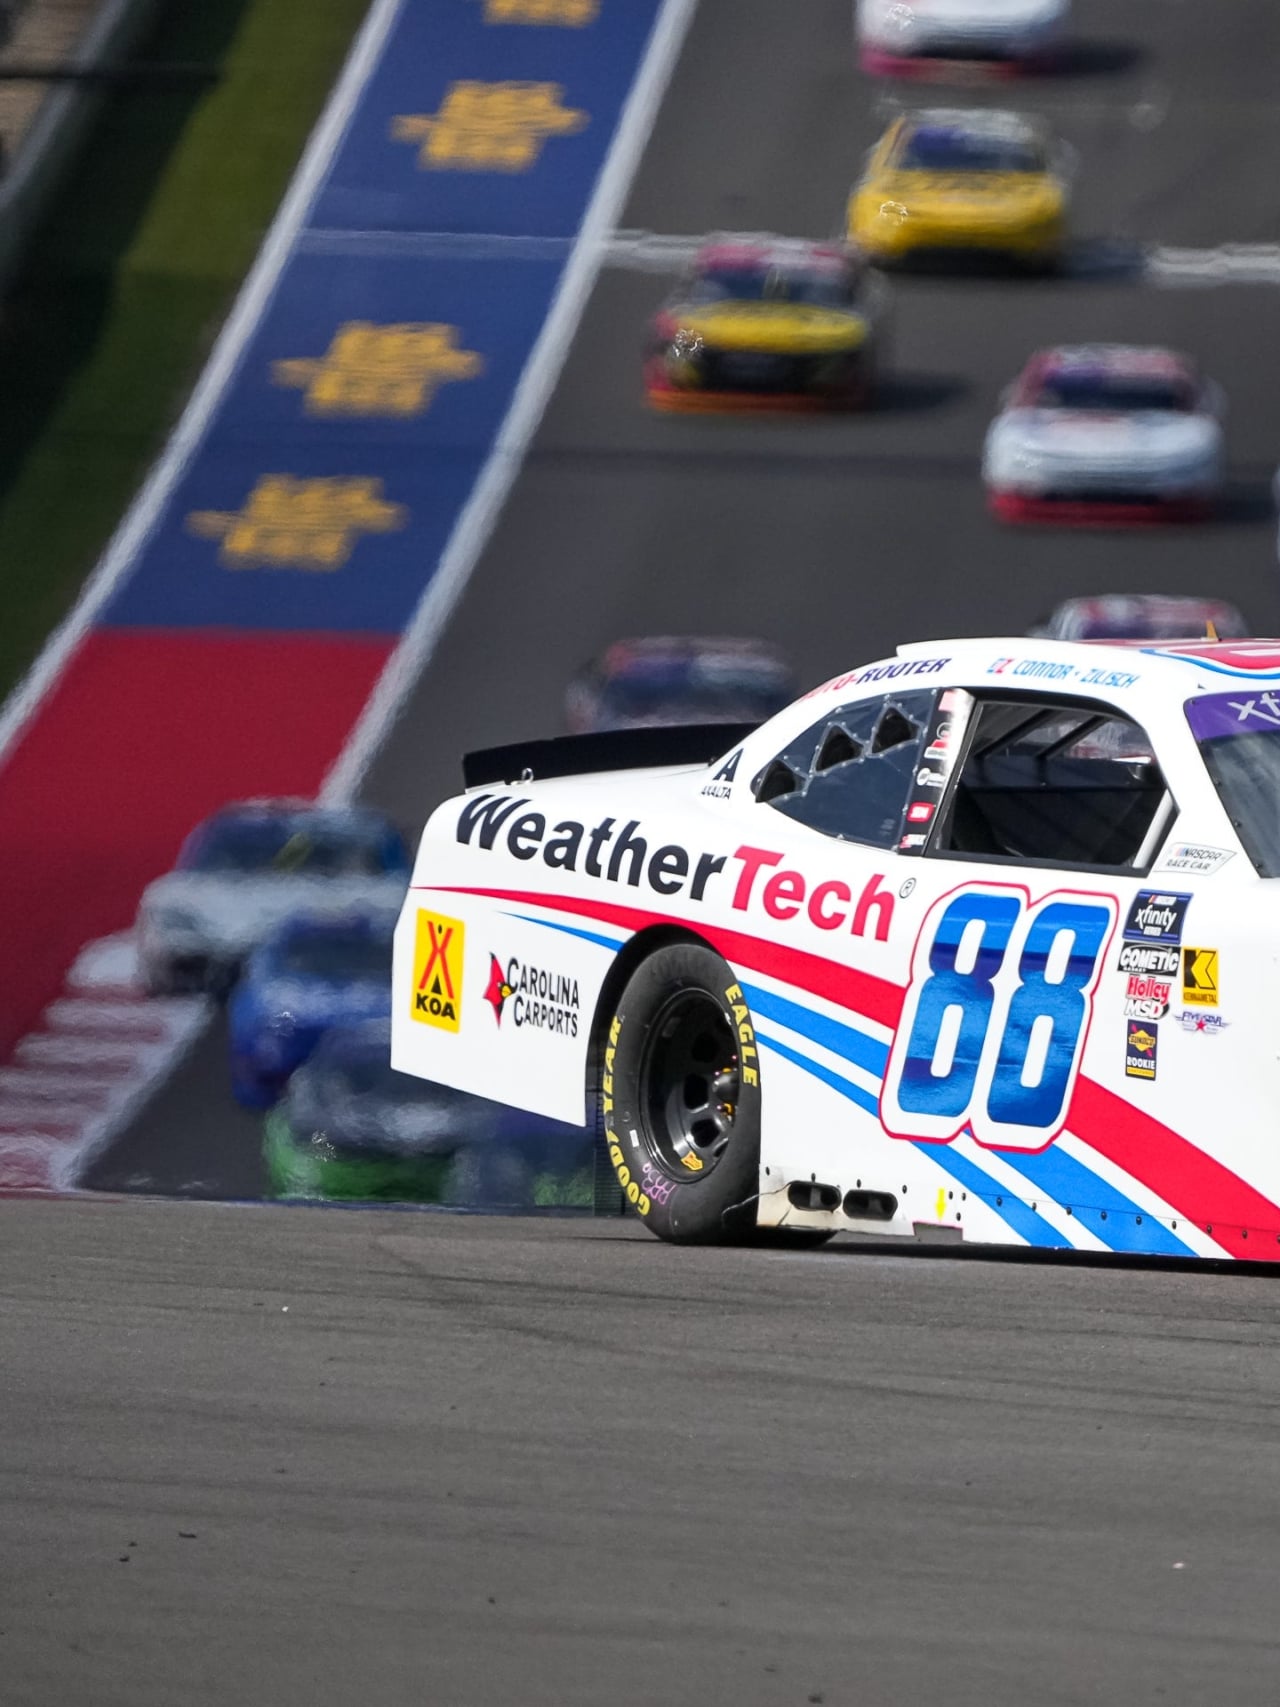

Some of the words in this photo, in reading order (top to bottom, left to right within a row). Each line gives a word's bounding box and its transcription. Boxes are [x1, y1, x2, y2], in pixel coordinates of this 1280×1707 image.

[1012, 660, 1075, 679] CONNOR
[456, 793, 895, 942] WeatherTech
[1190, 861, 1211, 870] CAR
[1135, 904, 1177, 932] xfinity
[1120, 947, 1179, 972] COMETIC
[507, 957, 579, 1009] CAROLINA
[1127, 975, 1171, 1005] Holley
[416, 993, 456, 1021] KOA
[514, 995, 578, 1038] CARPORTS
[880, 881, 1118, 1153] 88
[1125, 999, 1170, 1020] MSD
[724, 983, 758, 1087] EAGLE
[1127, 1056, 1155, 1069] ROOKIE
